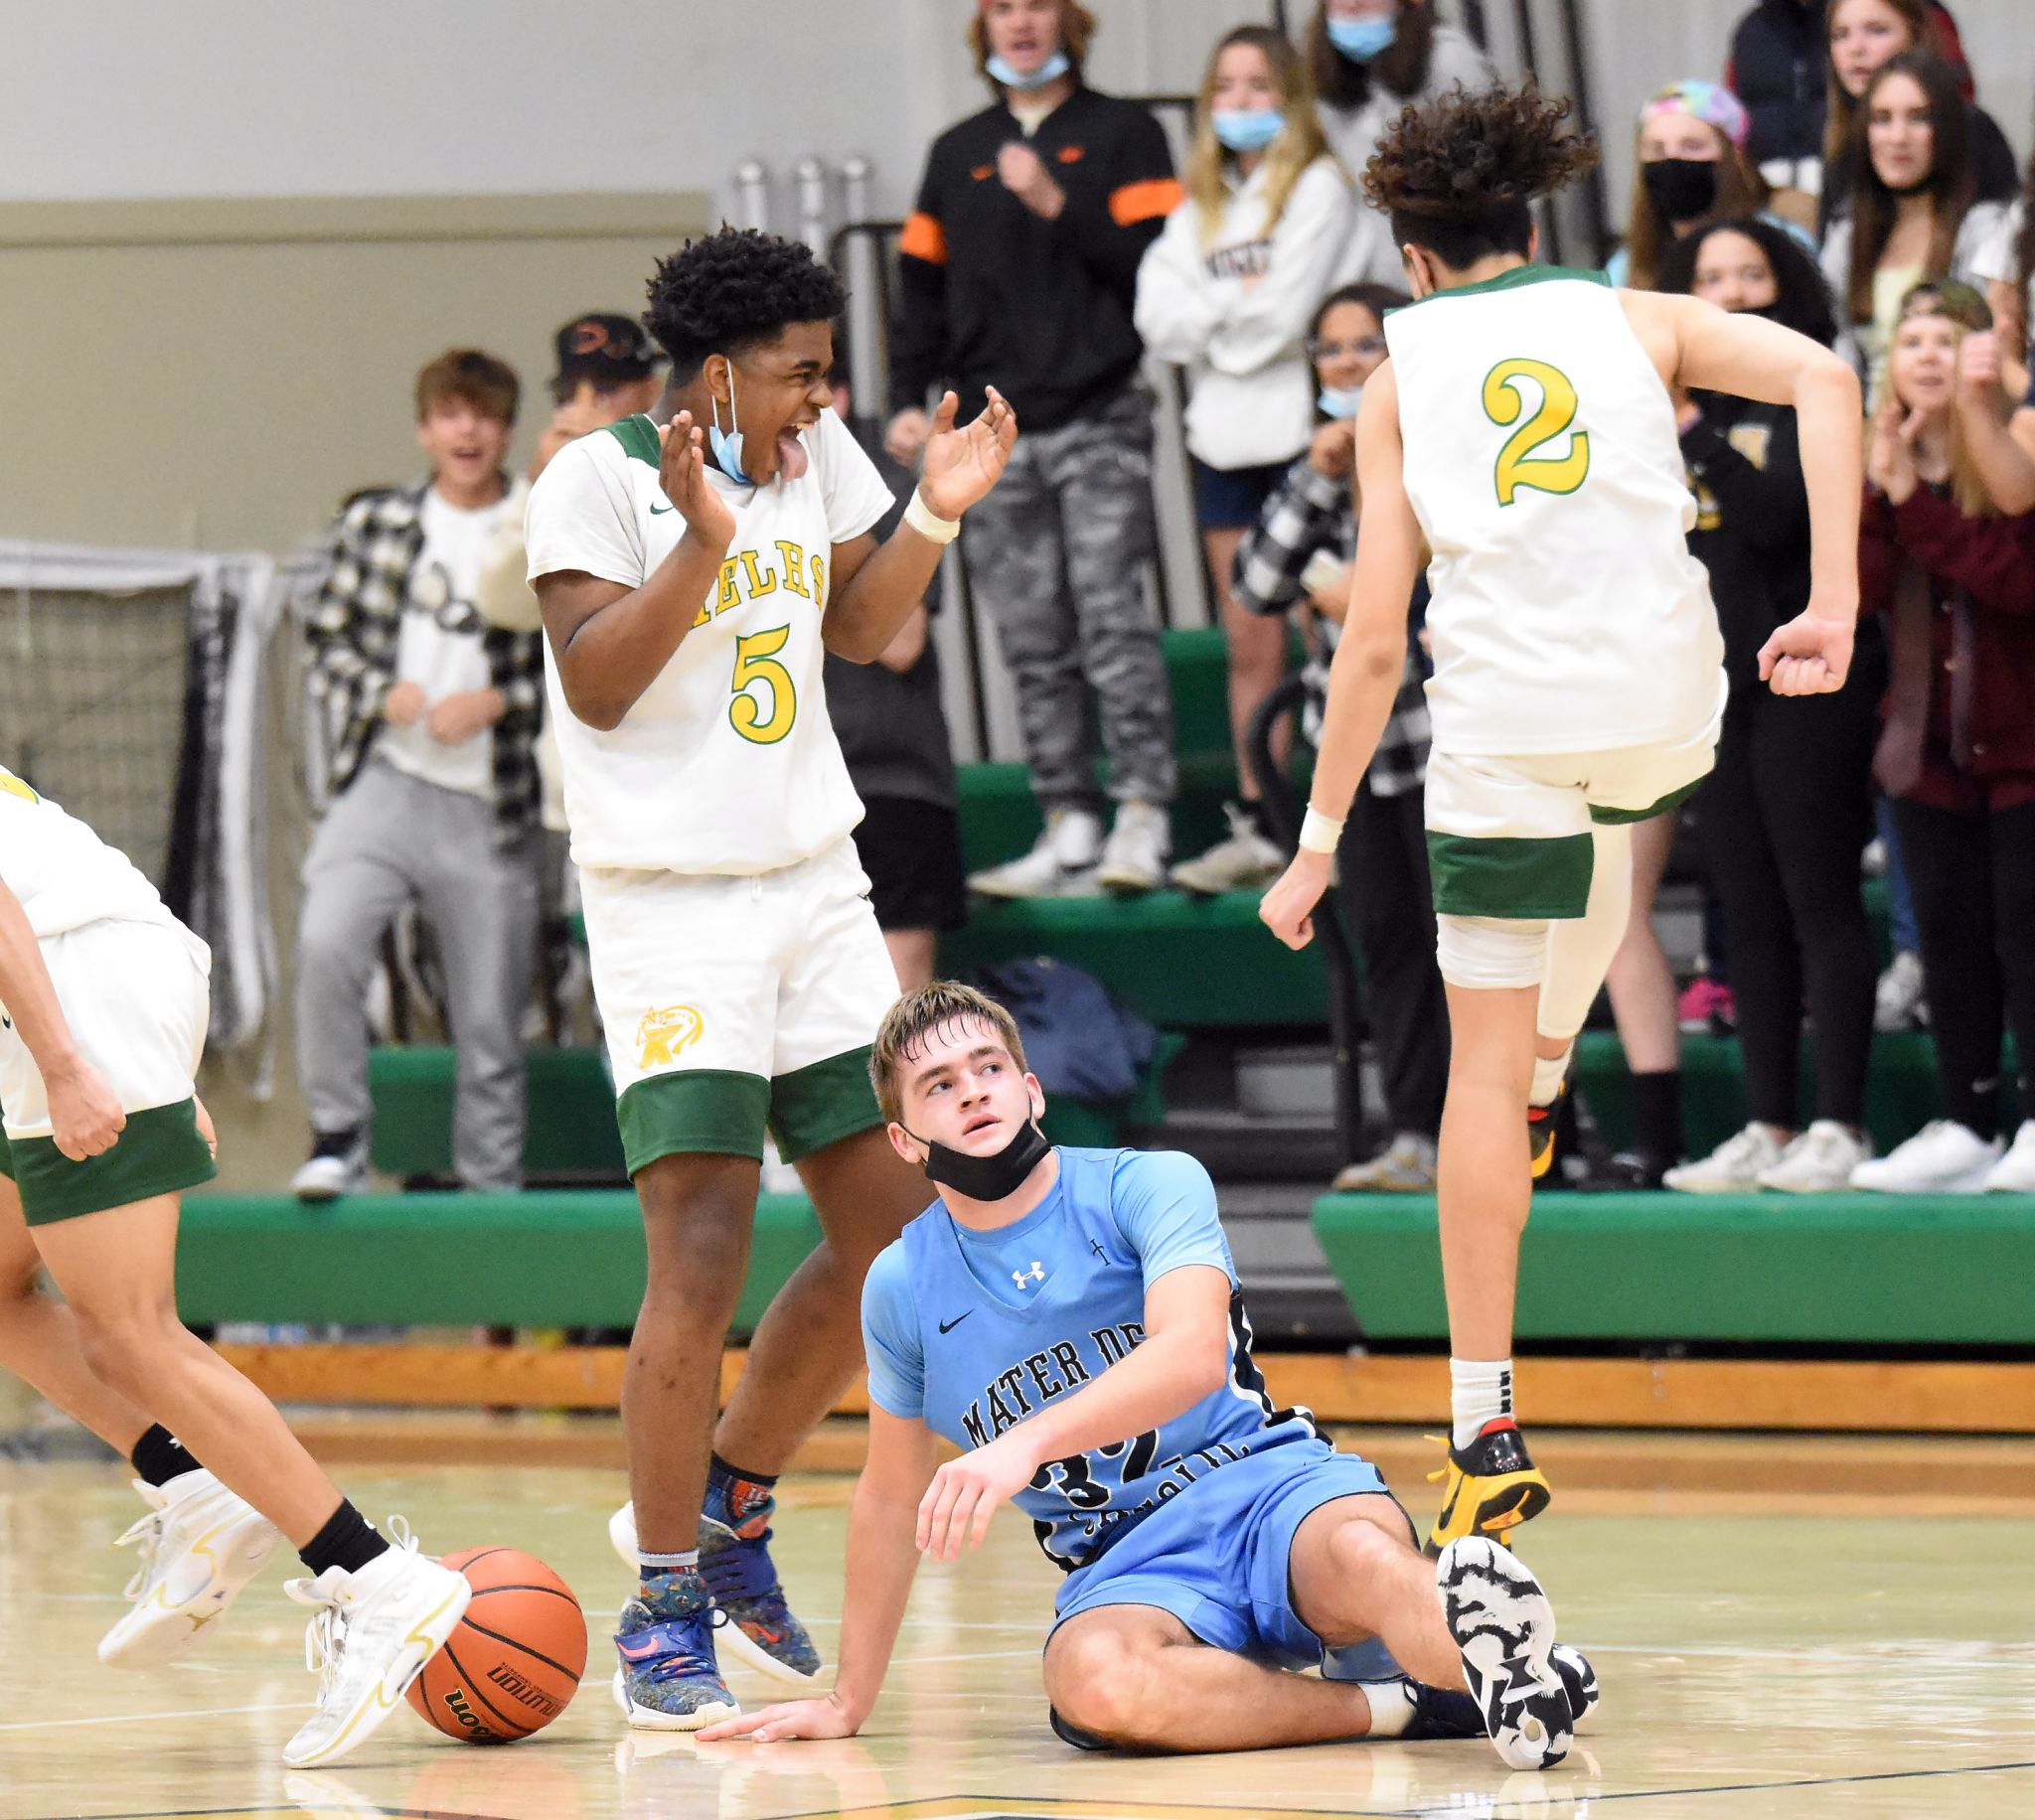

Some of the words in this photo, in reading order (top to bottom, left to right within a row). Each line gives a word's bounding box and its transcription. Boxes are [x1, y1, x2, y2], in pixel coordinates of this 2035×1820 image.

[1482, 358, 1590, 508] 2
[693, 539, 825, 628] ELHS
[728, 623, 797, 745] 5
[961, 1340, 1092, 1449] MATER
[1088, 1322, 1148, 1369] DE
